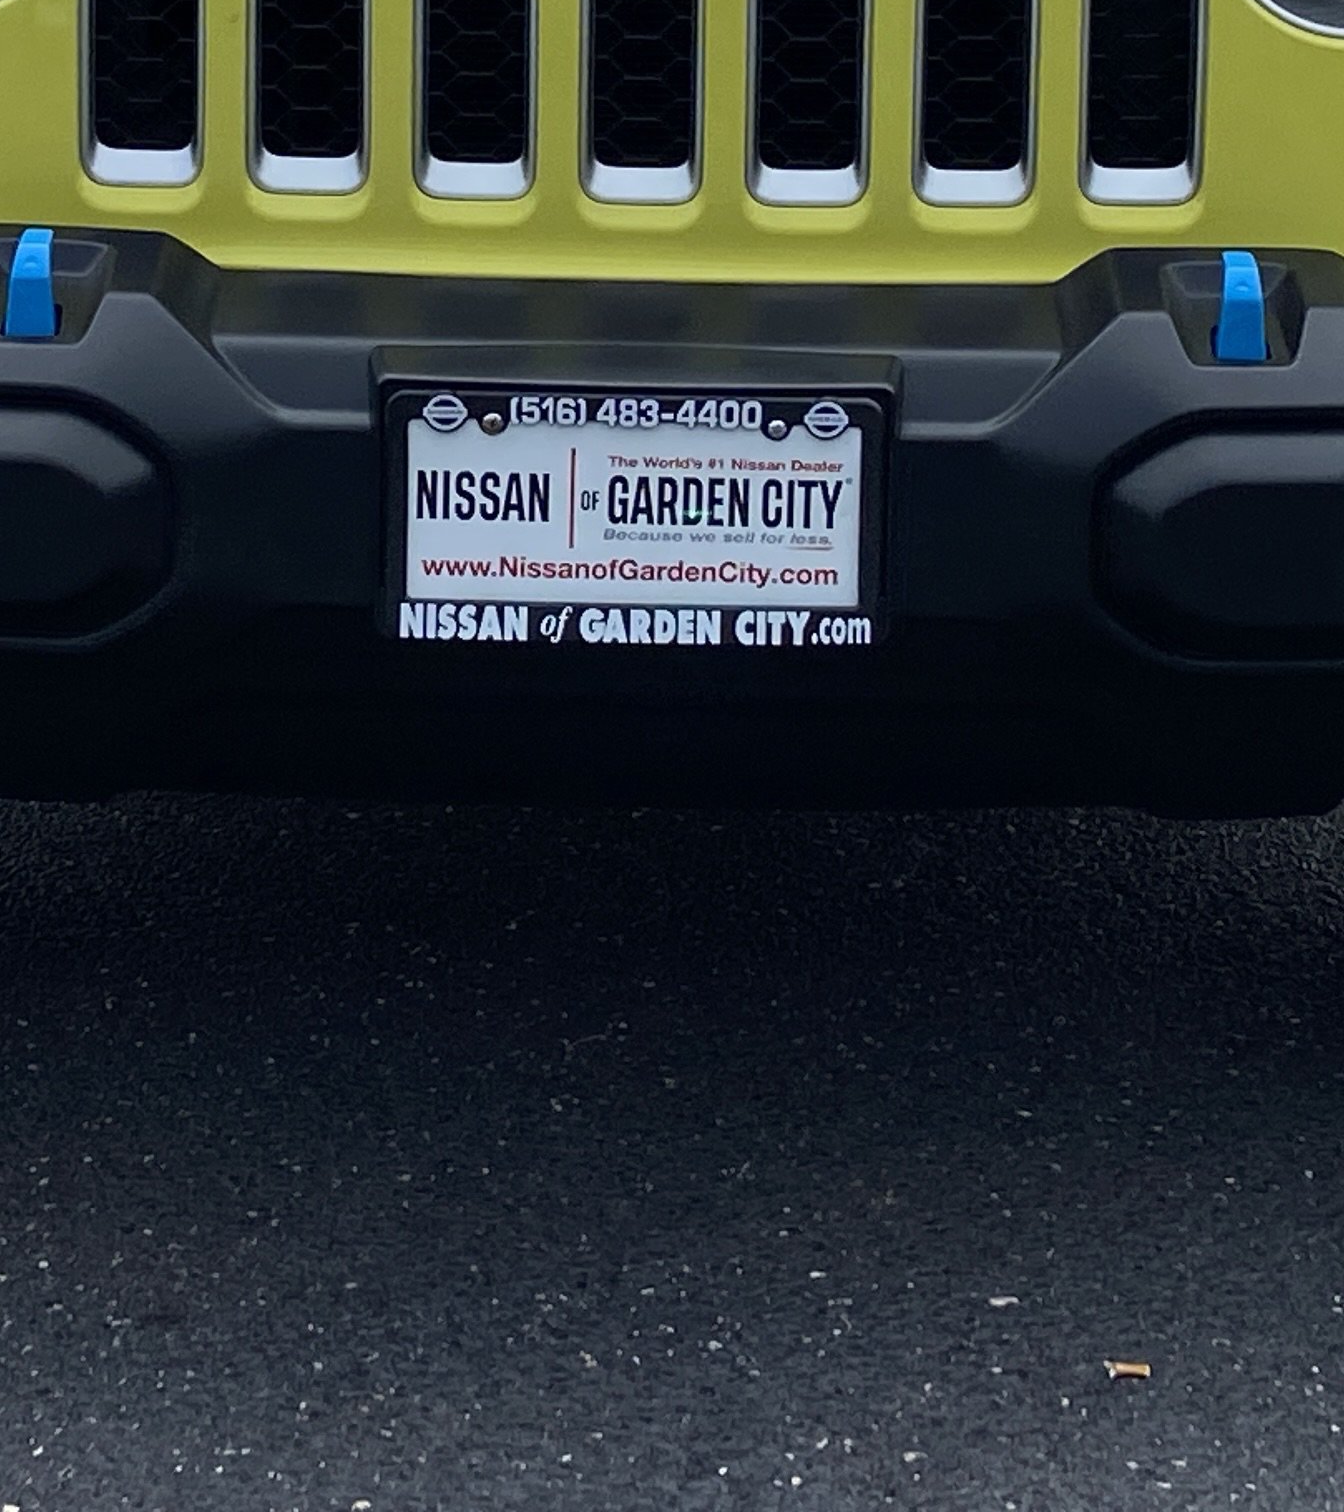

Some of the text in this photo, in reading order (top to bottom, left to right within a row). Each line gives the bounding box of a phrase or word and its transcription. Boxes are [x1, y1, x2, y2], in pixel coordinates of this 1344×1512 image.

[510, 397, 763, 429] (516) 483-4400
[608, 455, 844, 473] The World's #1 Nissan Dealer
[416, 470, 843, 529] NISSAN OF GARDEN CITY
[603, 528, 682, 542] Because
[689, 532, 716, 543] we
[723, 531, 755, 544] sell
[760, 532, 784, 544] for
[421, 556, 839, 588] www.NissanofGardenCity.com
[399, 603, 872, 646] NISSAN of GARDEN CITY.com
